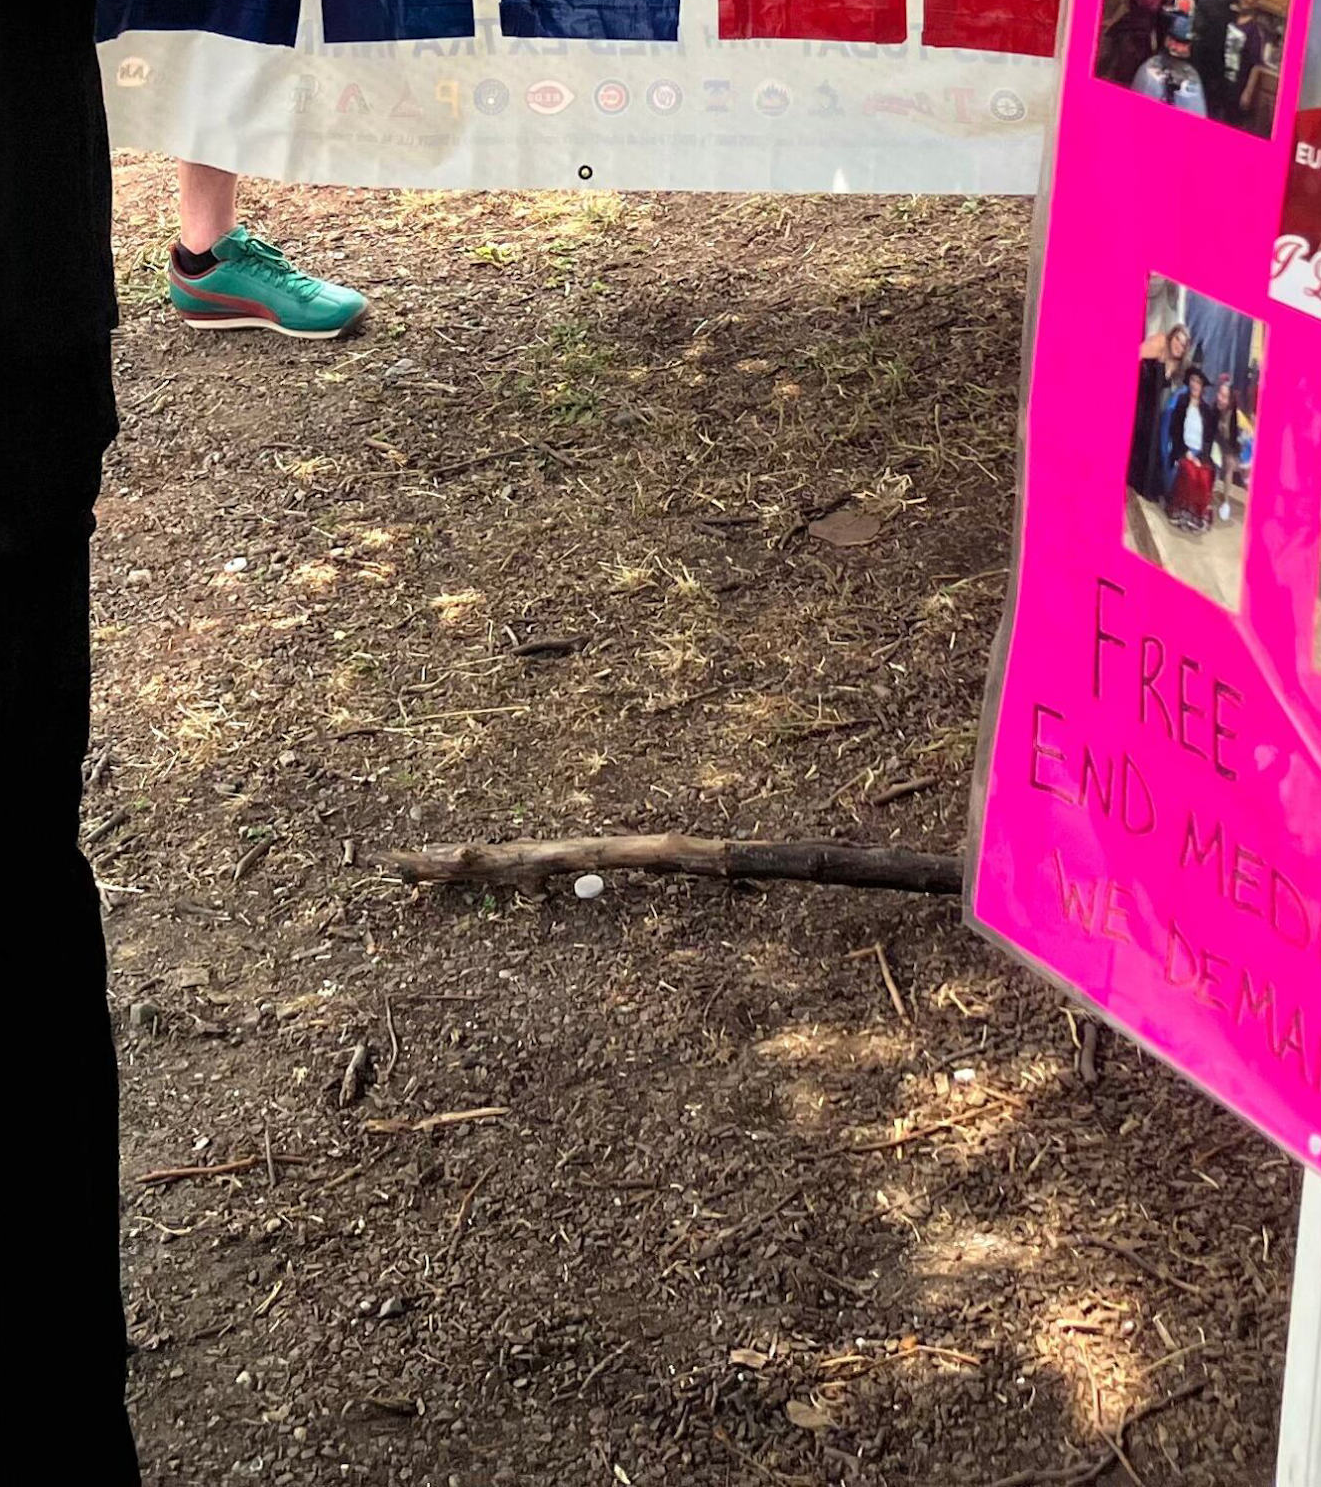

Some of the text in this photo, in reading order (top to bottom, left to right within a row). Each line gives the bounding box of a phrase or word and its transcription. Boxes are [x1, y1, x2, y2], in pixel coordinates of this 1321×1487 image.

[1091, 576, 1242, 782] FREE
[1031, 703, 1156, 835] END
[1049, 849, 1131, 945] WE
